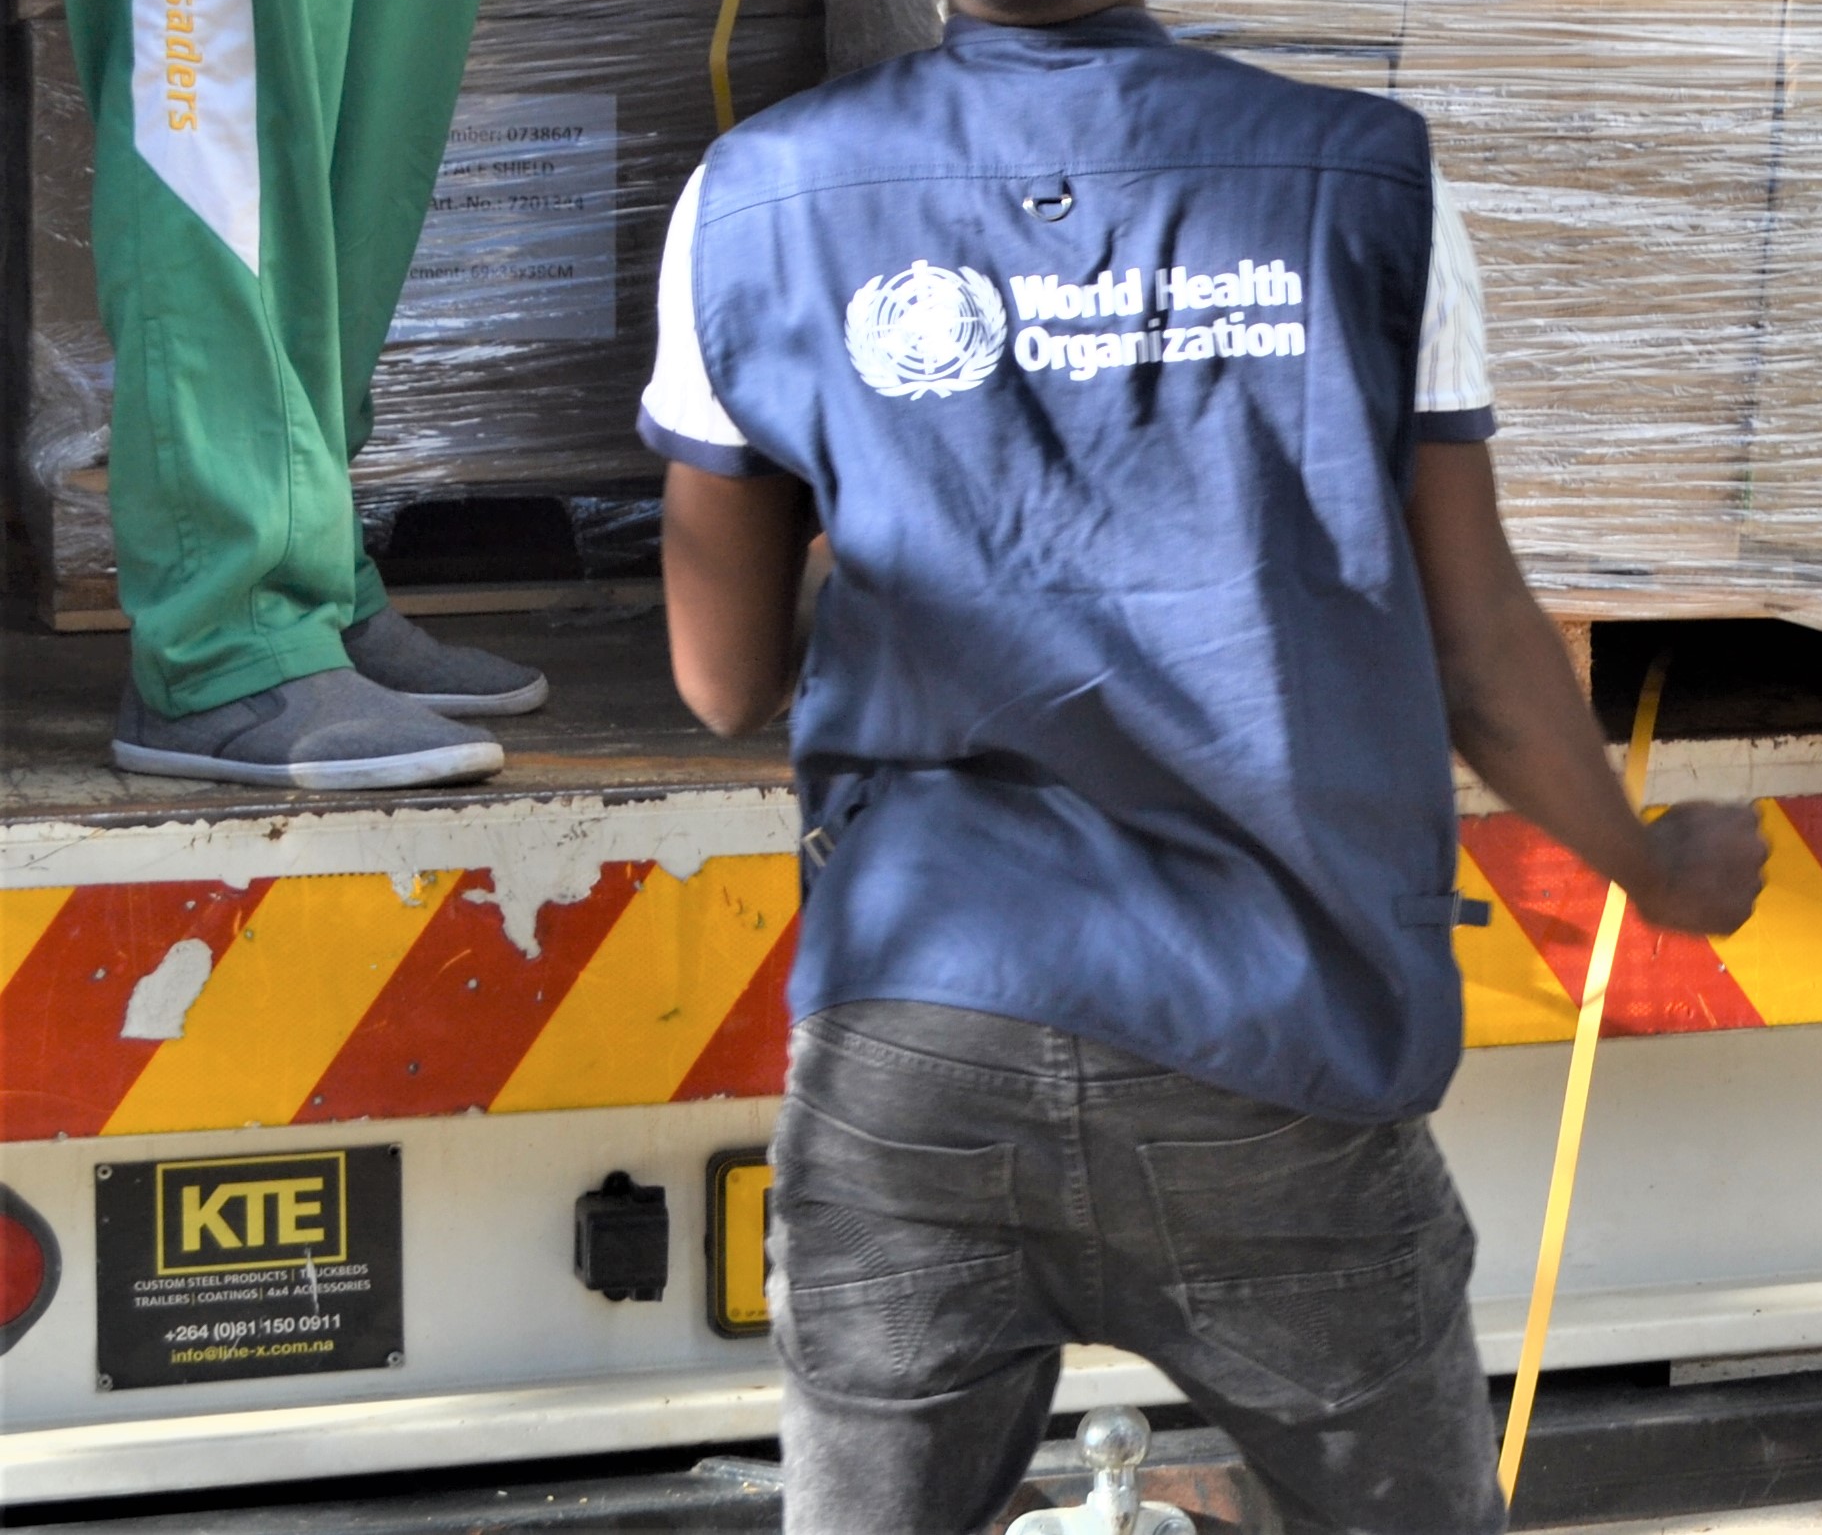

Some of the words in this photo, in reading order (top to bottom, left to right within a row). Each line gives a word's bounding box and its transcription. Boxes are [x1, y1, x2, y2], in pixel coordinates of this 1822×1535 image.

[451, 125, 500, 143] mber:
[506, 126, 583, 143] 0738647
[493, 161, 555, 177] SHIELD
[508, 196, 584, 212] 7201344
[410, 265, 465, 280] ement:
[1010, 267, 1143, 321] World
[1155, 259, 1303, 312] Health
[1014, 312, 1306, 381] Organization
[182, 1177, 325, 1252] KTE
[134, 1277, 185, 1292] CUSTOM
[187, 1275, 222, 1289] STEEL
[224, 1270, 288, 1287] PRODUCTS
[301, 1263, 369, 1279] TUCKBEDS
[134, 1293, 190, 1308] TRAILERS
[197, 1289, 259, 1304] COATINGS
[266, 1285, 289, 1298] 4x4
[293, 1279, 371, 1296] ACCESSORIES
[164, 1324, 209, 1343] +264
[213, 1320, 256, 1342] (0)81
[263, 1316, 295, 1334] 150
[299, 1313, 341, 1332] 0911
[170, 1339, 334, 1364] info@line-x.com.na
